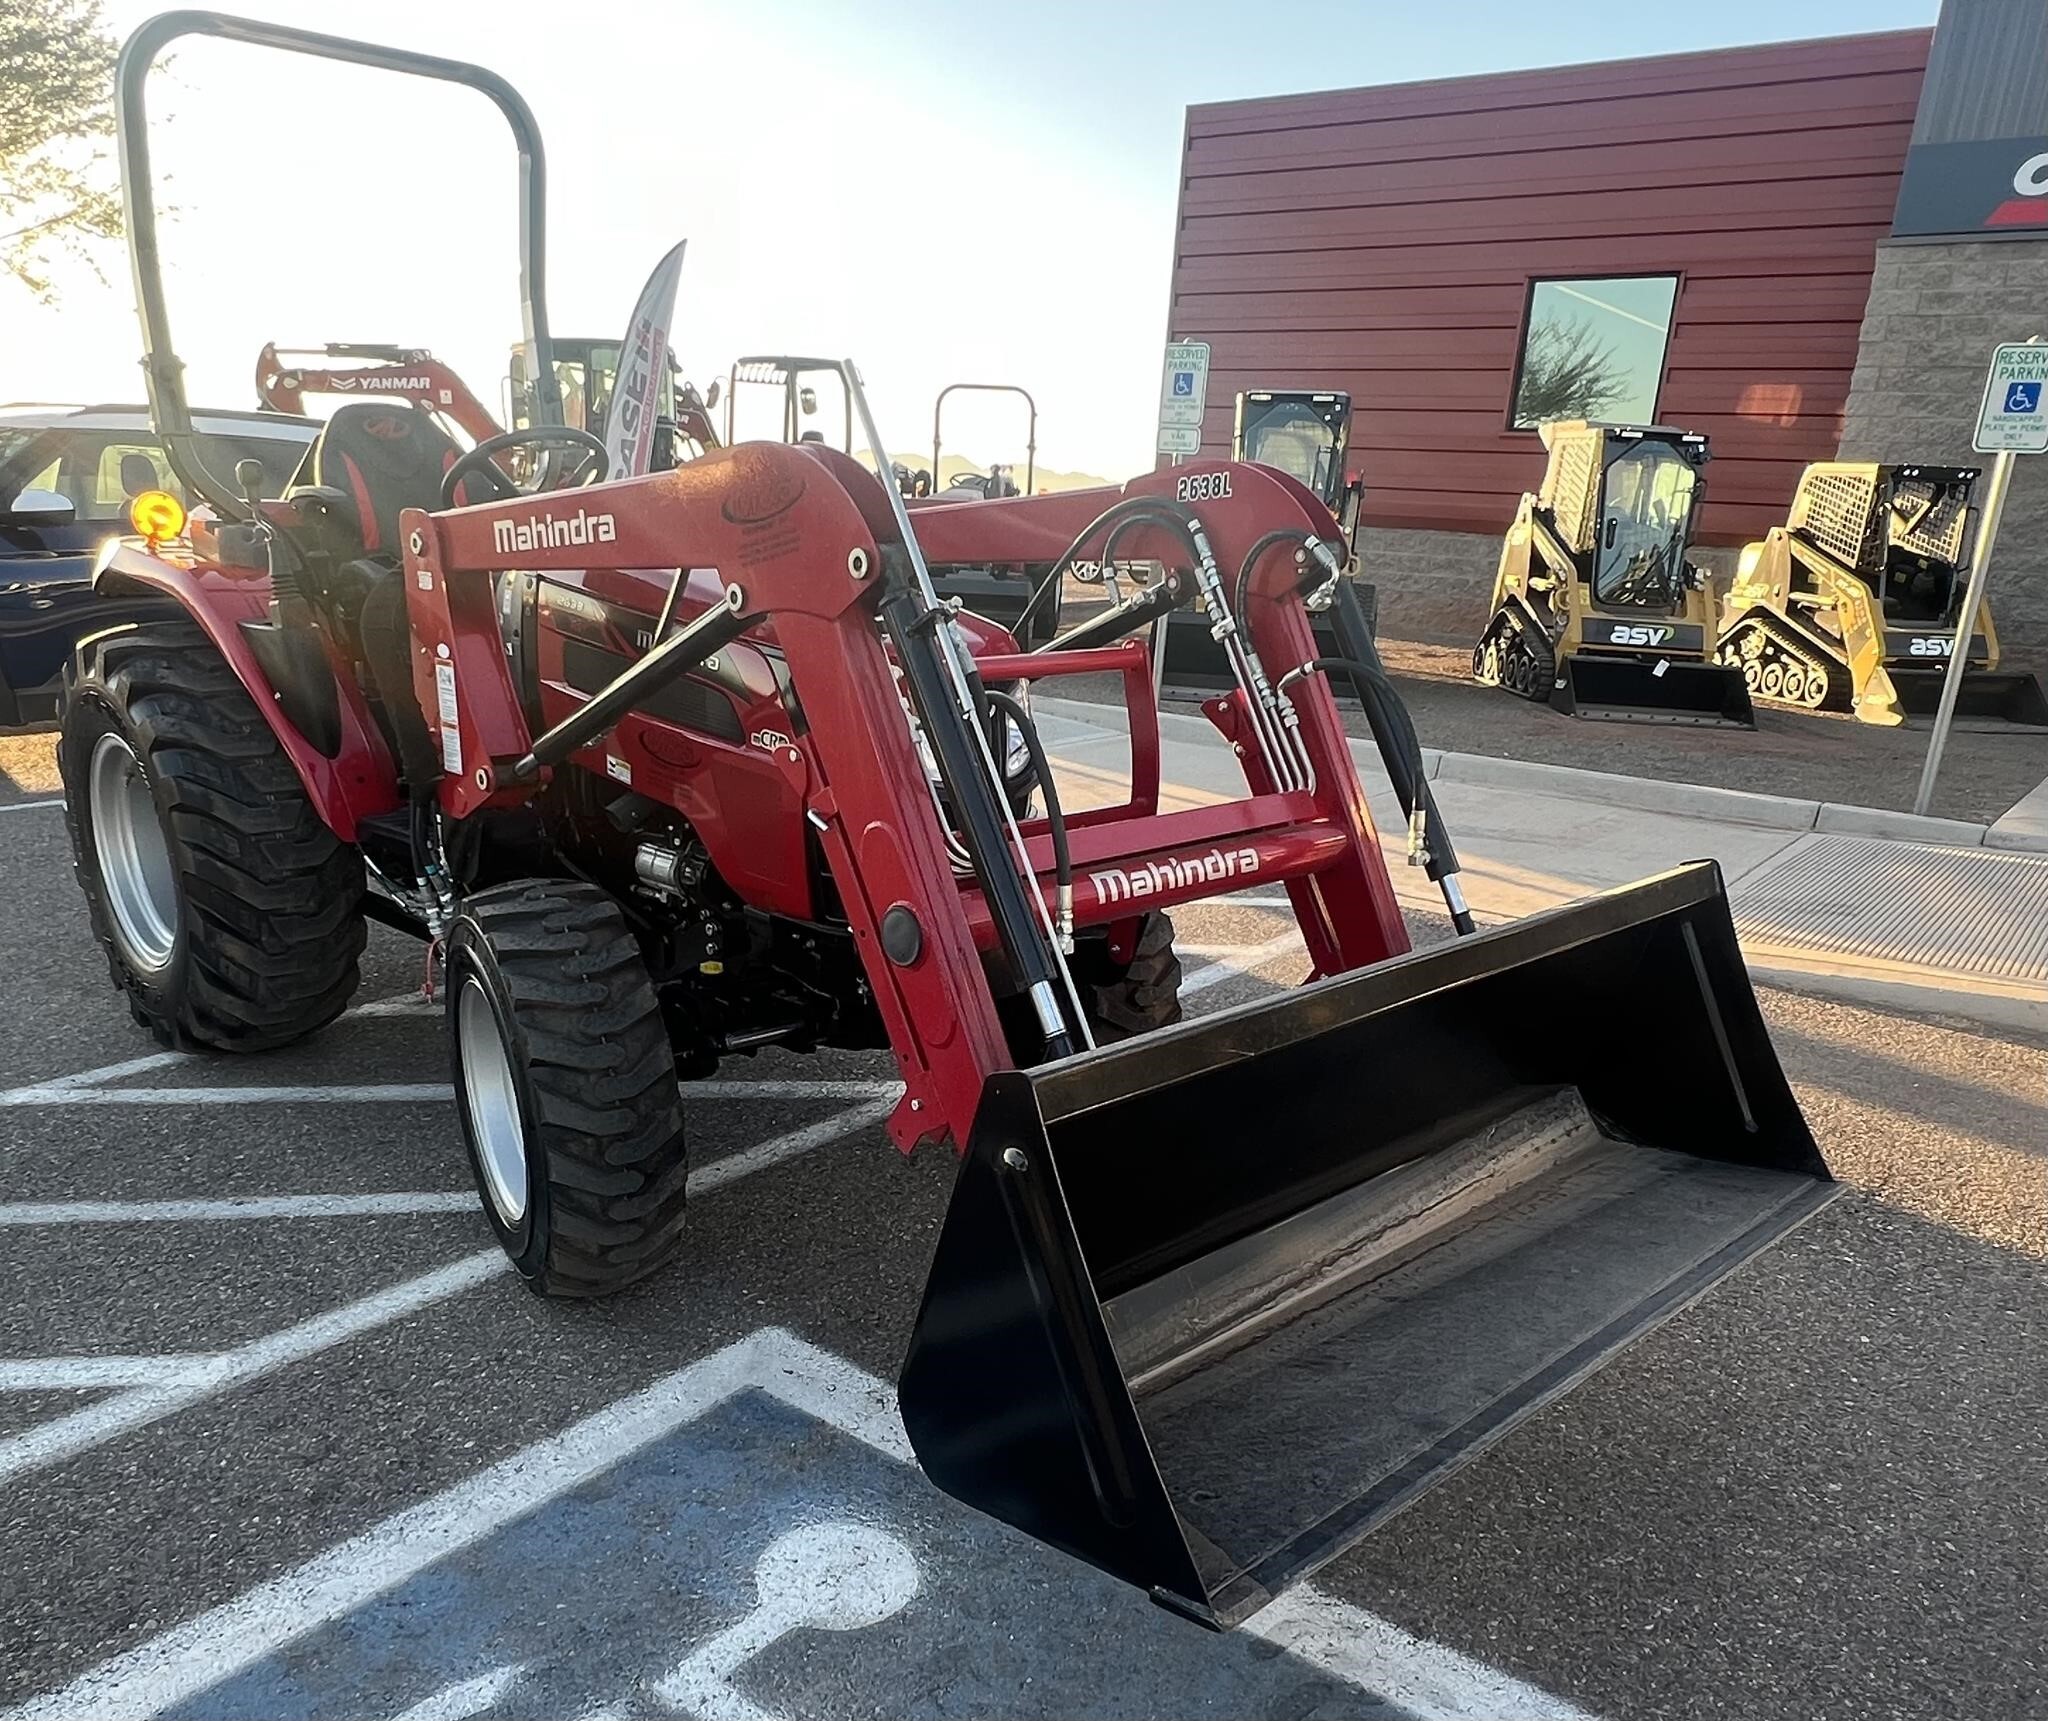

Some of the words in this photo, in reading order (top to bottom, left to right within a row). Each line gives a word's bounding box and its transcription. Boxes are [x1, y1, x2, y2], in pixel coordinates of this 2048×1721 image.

[1168, 348, 1205, 359] RESERVED
[1168, 360, 1203, 371] PARKING
[360, 377, 431, 389] YANMAR
[1177, 472, 1232, 502] 2638L
[493, 509, 616, 553] Mahindra
[1089, 848, 1259, 904] Mahindra
